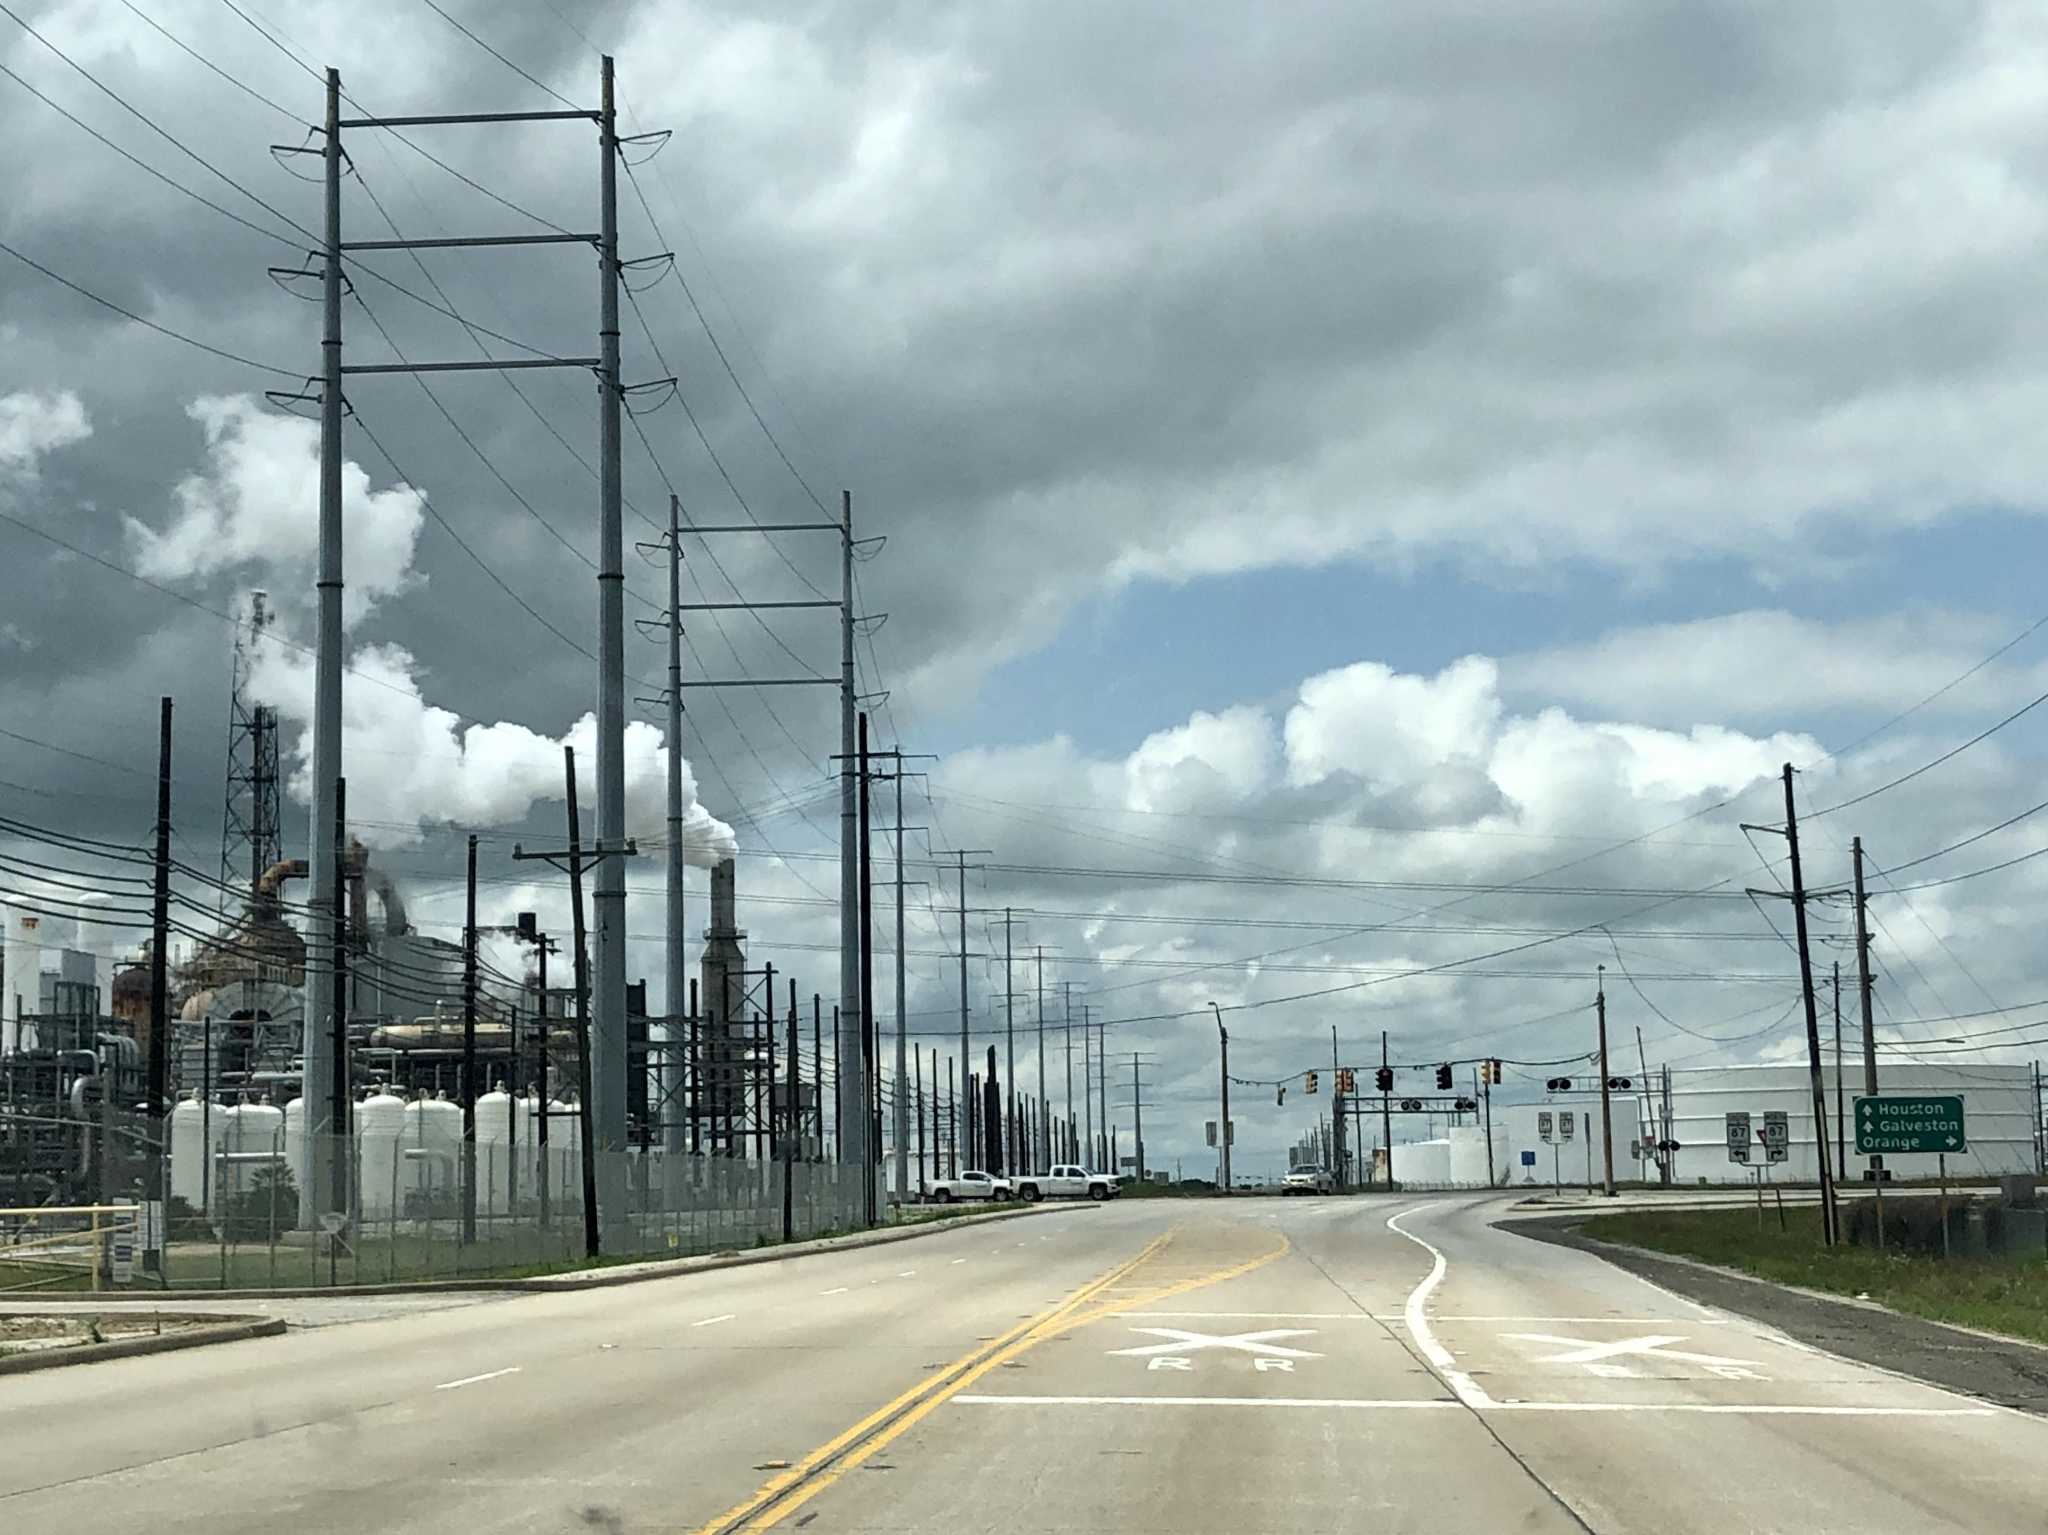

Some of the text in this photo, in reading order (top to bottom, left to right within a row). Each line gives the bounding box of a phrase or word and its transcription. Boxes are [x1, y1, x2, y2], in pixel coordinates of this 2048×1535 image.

[1879, 1104, 1944, 1115] Houston
[1731, 1127, 1746, 1137] 87
[1768, 1126, 1783, 1137] 87
[1880, 1120, 1958, 1132] Galveston
[1863, 1136, 1920, 1150] Orange
[1147, 1357, 1295, 1372] R R
[1703, 1365, 1773, 1381] R
